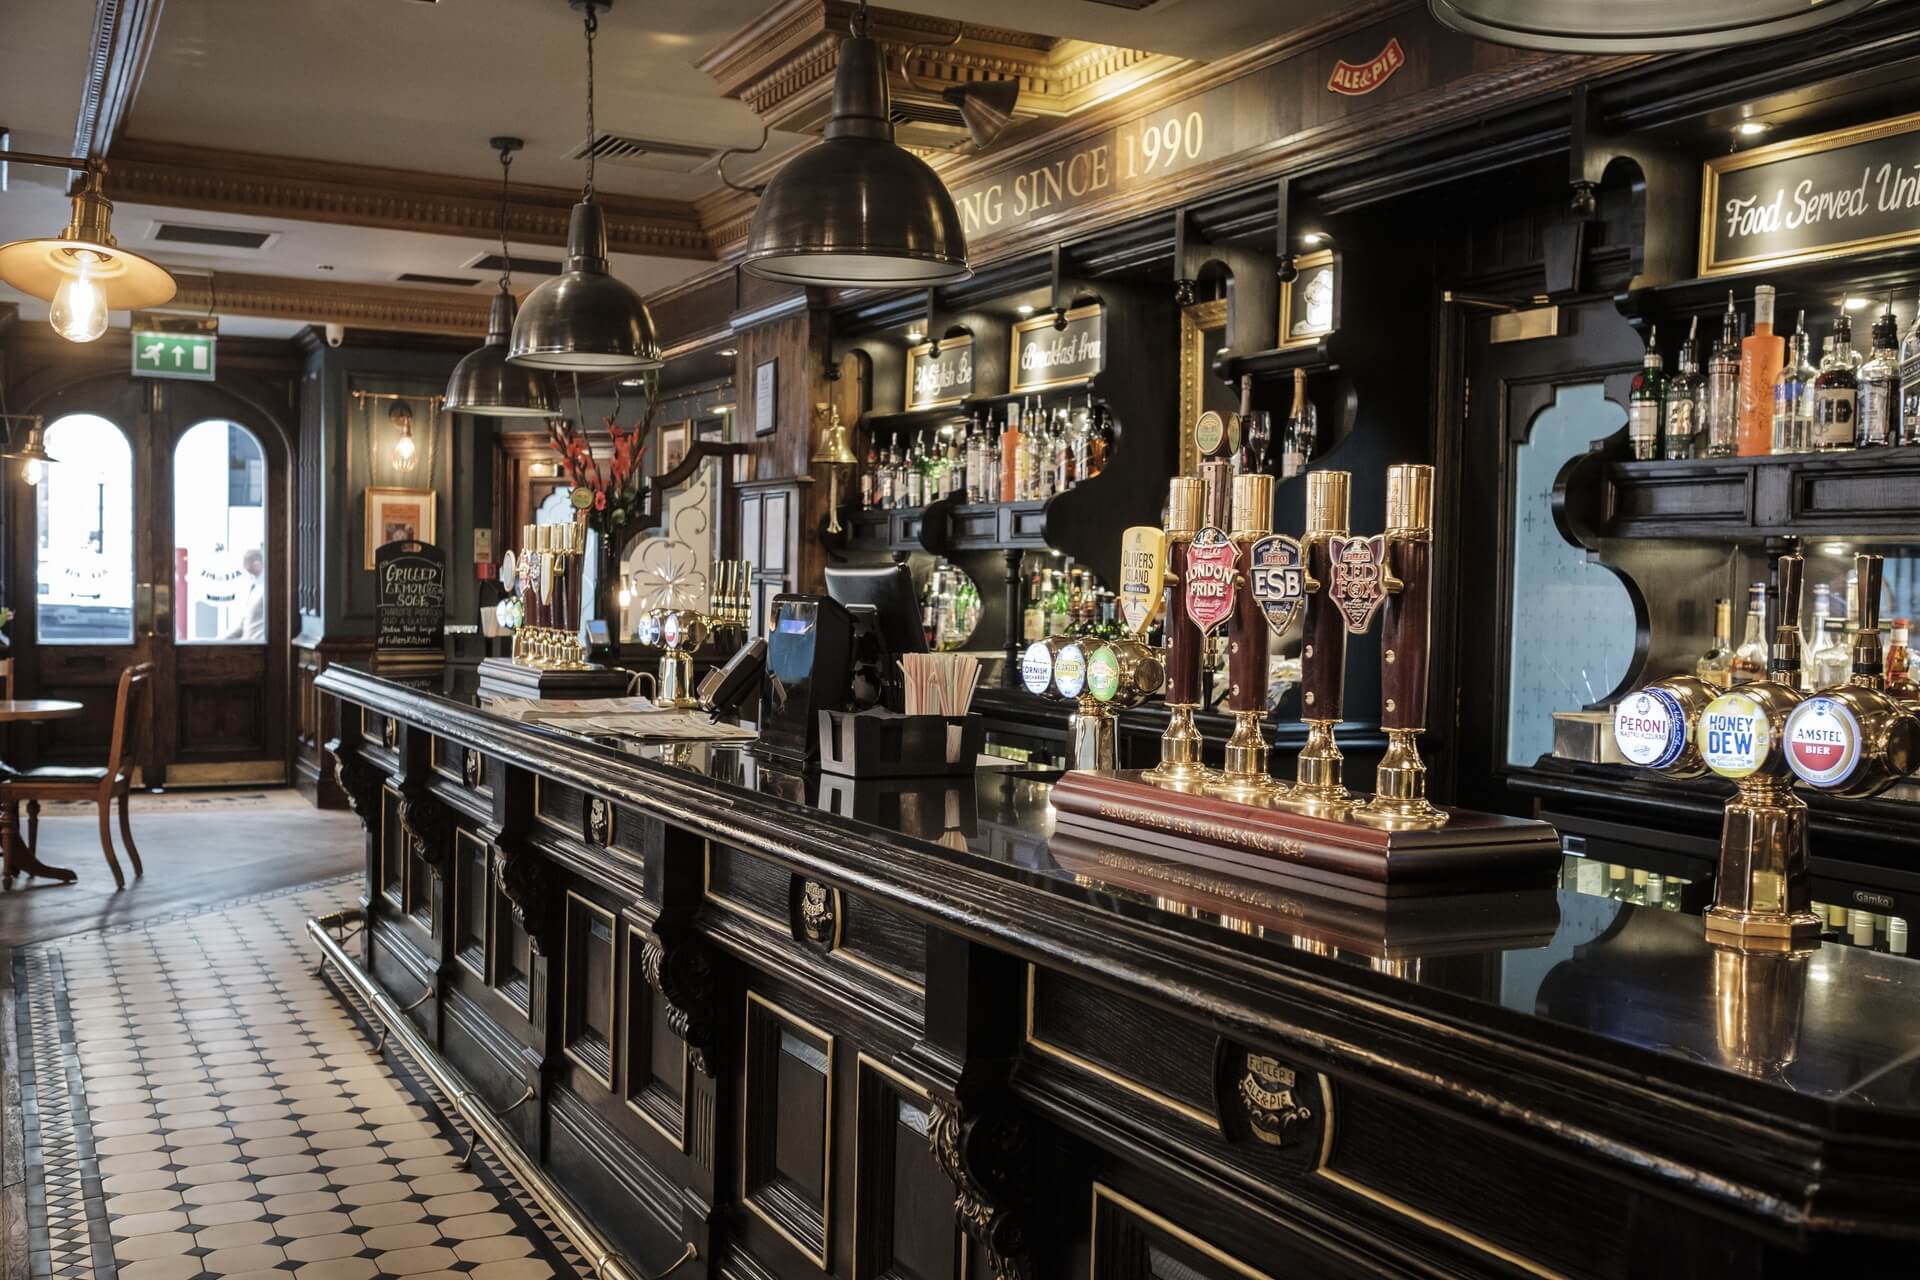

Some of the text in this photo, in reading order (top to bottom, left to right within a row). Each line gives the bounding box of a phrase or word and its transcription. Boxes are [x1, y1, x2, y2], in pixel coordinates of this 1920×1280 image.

[956, 111, 1204, 233] NG SINCE 1990
[1726, 189, 1784, 238] Food
[1786, 166, 1871, 230] Served
[1022, 335, 1078, 369] Breakfast
[1125, 568, 1149, 583] ISLAND
[1186, 564, 1233, 584] LONDON
[1336, 565, 1378, 581] RED
[1190, 582, 1225, 597] PRIDE
[1254, 569, 1300, 599] ESB
[1336, 580, 1378, 599] FOX
[1620, 716, 1667, 734] PERONI
[1709, 715, 1754, 733] HONEY
[1709, 731, 1753, 755] DEW
[1797, 728, 1842, 743] AMSTEL
[1805, 745, 1831, 756] BIER
[1139, 810, 1172, 830] BESIDE
[1173, 816, 1193, 834] THE
[1195, 823, 1239, 844] THAMES
[1240, 831, 1274, 852] SINCE
[1278, 839, 1306, 858] 1845
[1856, 891, 1889, 906] Gamko
[1248, 1056, 1295, 1083] FULLER'S
